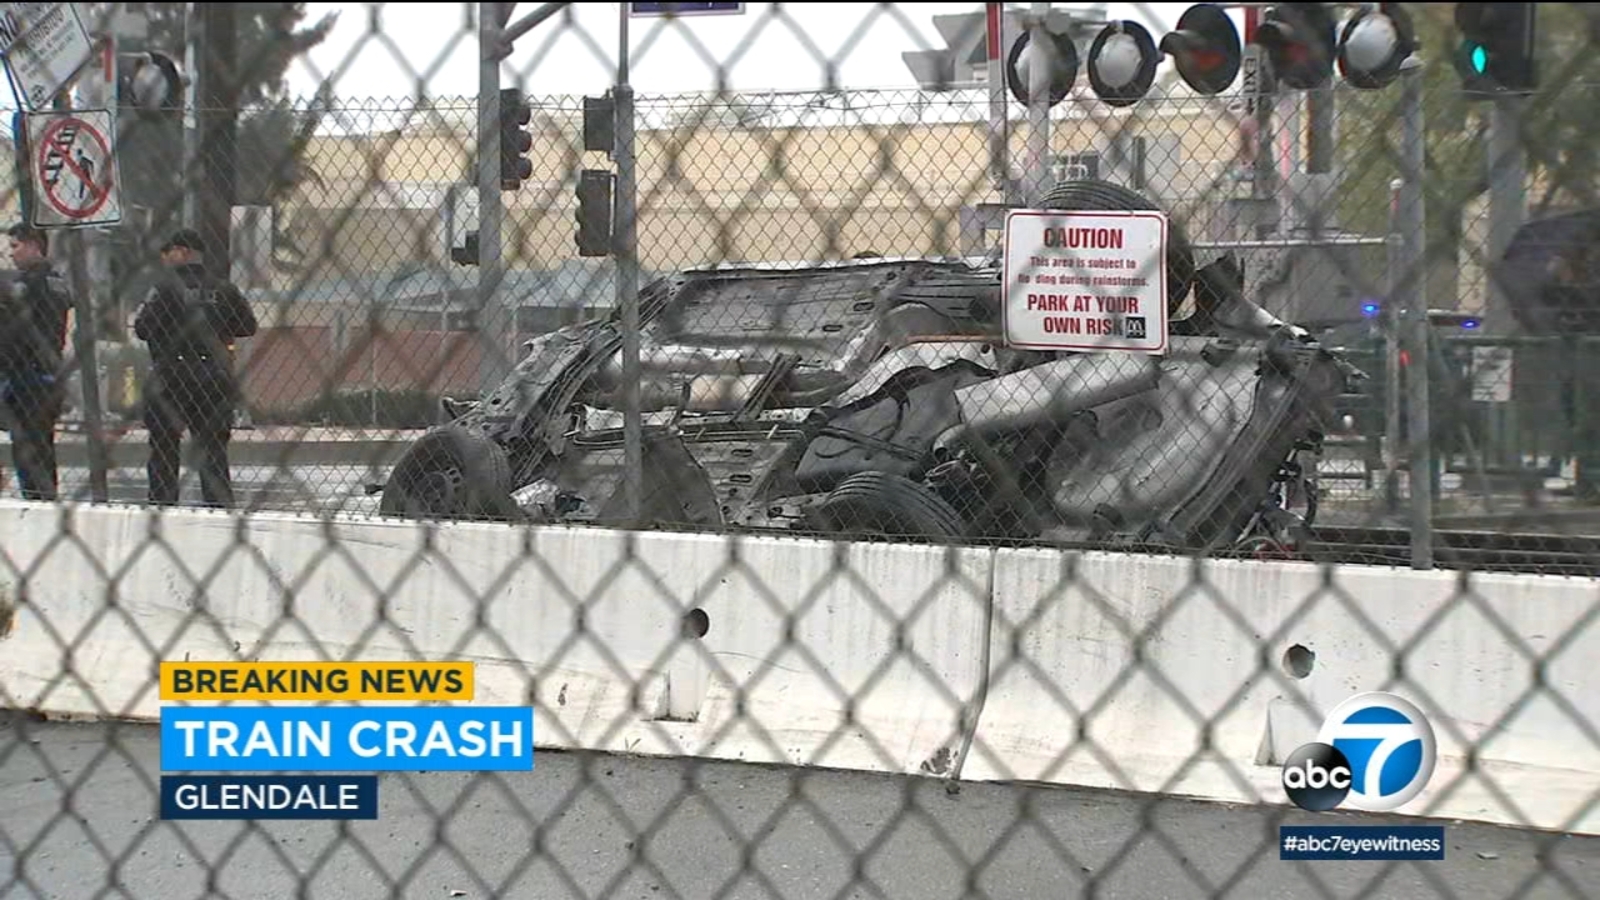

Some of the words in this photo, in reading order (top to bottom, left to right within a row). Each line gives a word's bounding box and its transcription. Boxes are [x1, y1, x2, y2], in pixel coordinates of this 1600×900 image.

[1043, 227, 1124, 249] CAUTION
[1030, 256, 1050, 268] This
[1052, 259, 1074, 268] area
[1076, 258, 1085, 268] is
[1088, 258, 1124, 270] subject
[1126, 259, 1136, 269] to
[1059, 274, 1091, 287] during
[1027, 294, 1069, 312] PARK
[1073, 295, 1092, 312] AT
[1096, 296, 1139, 314] YOUR
[1044, 316, 1081, 334] OWN
[1086, 318, 1123, 336] RISK
